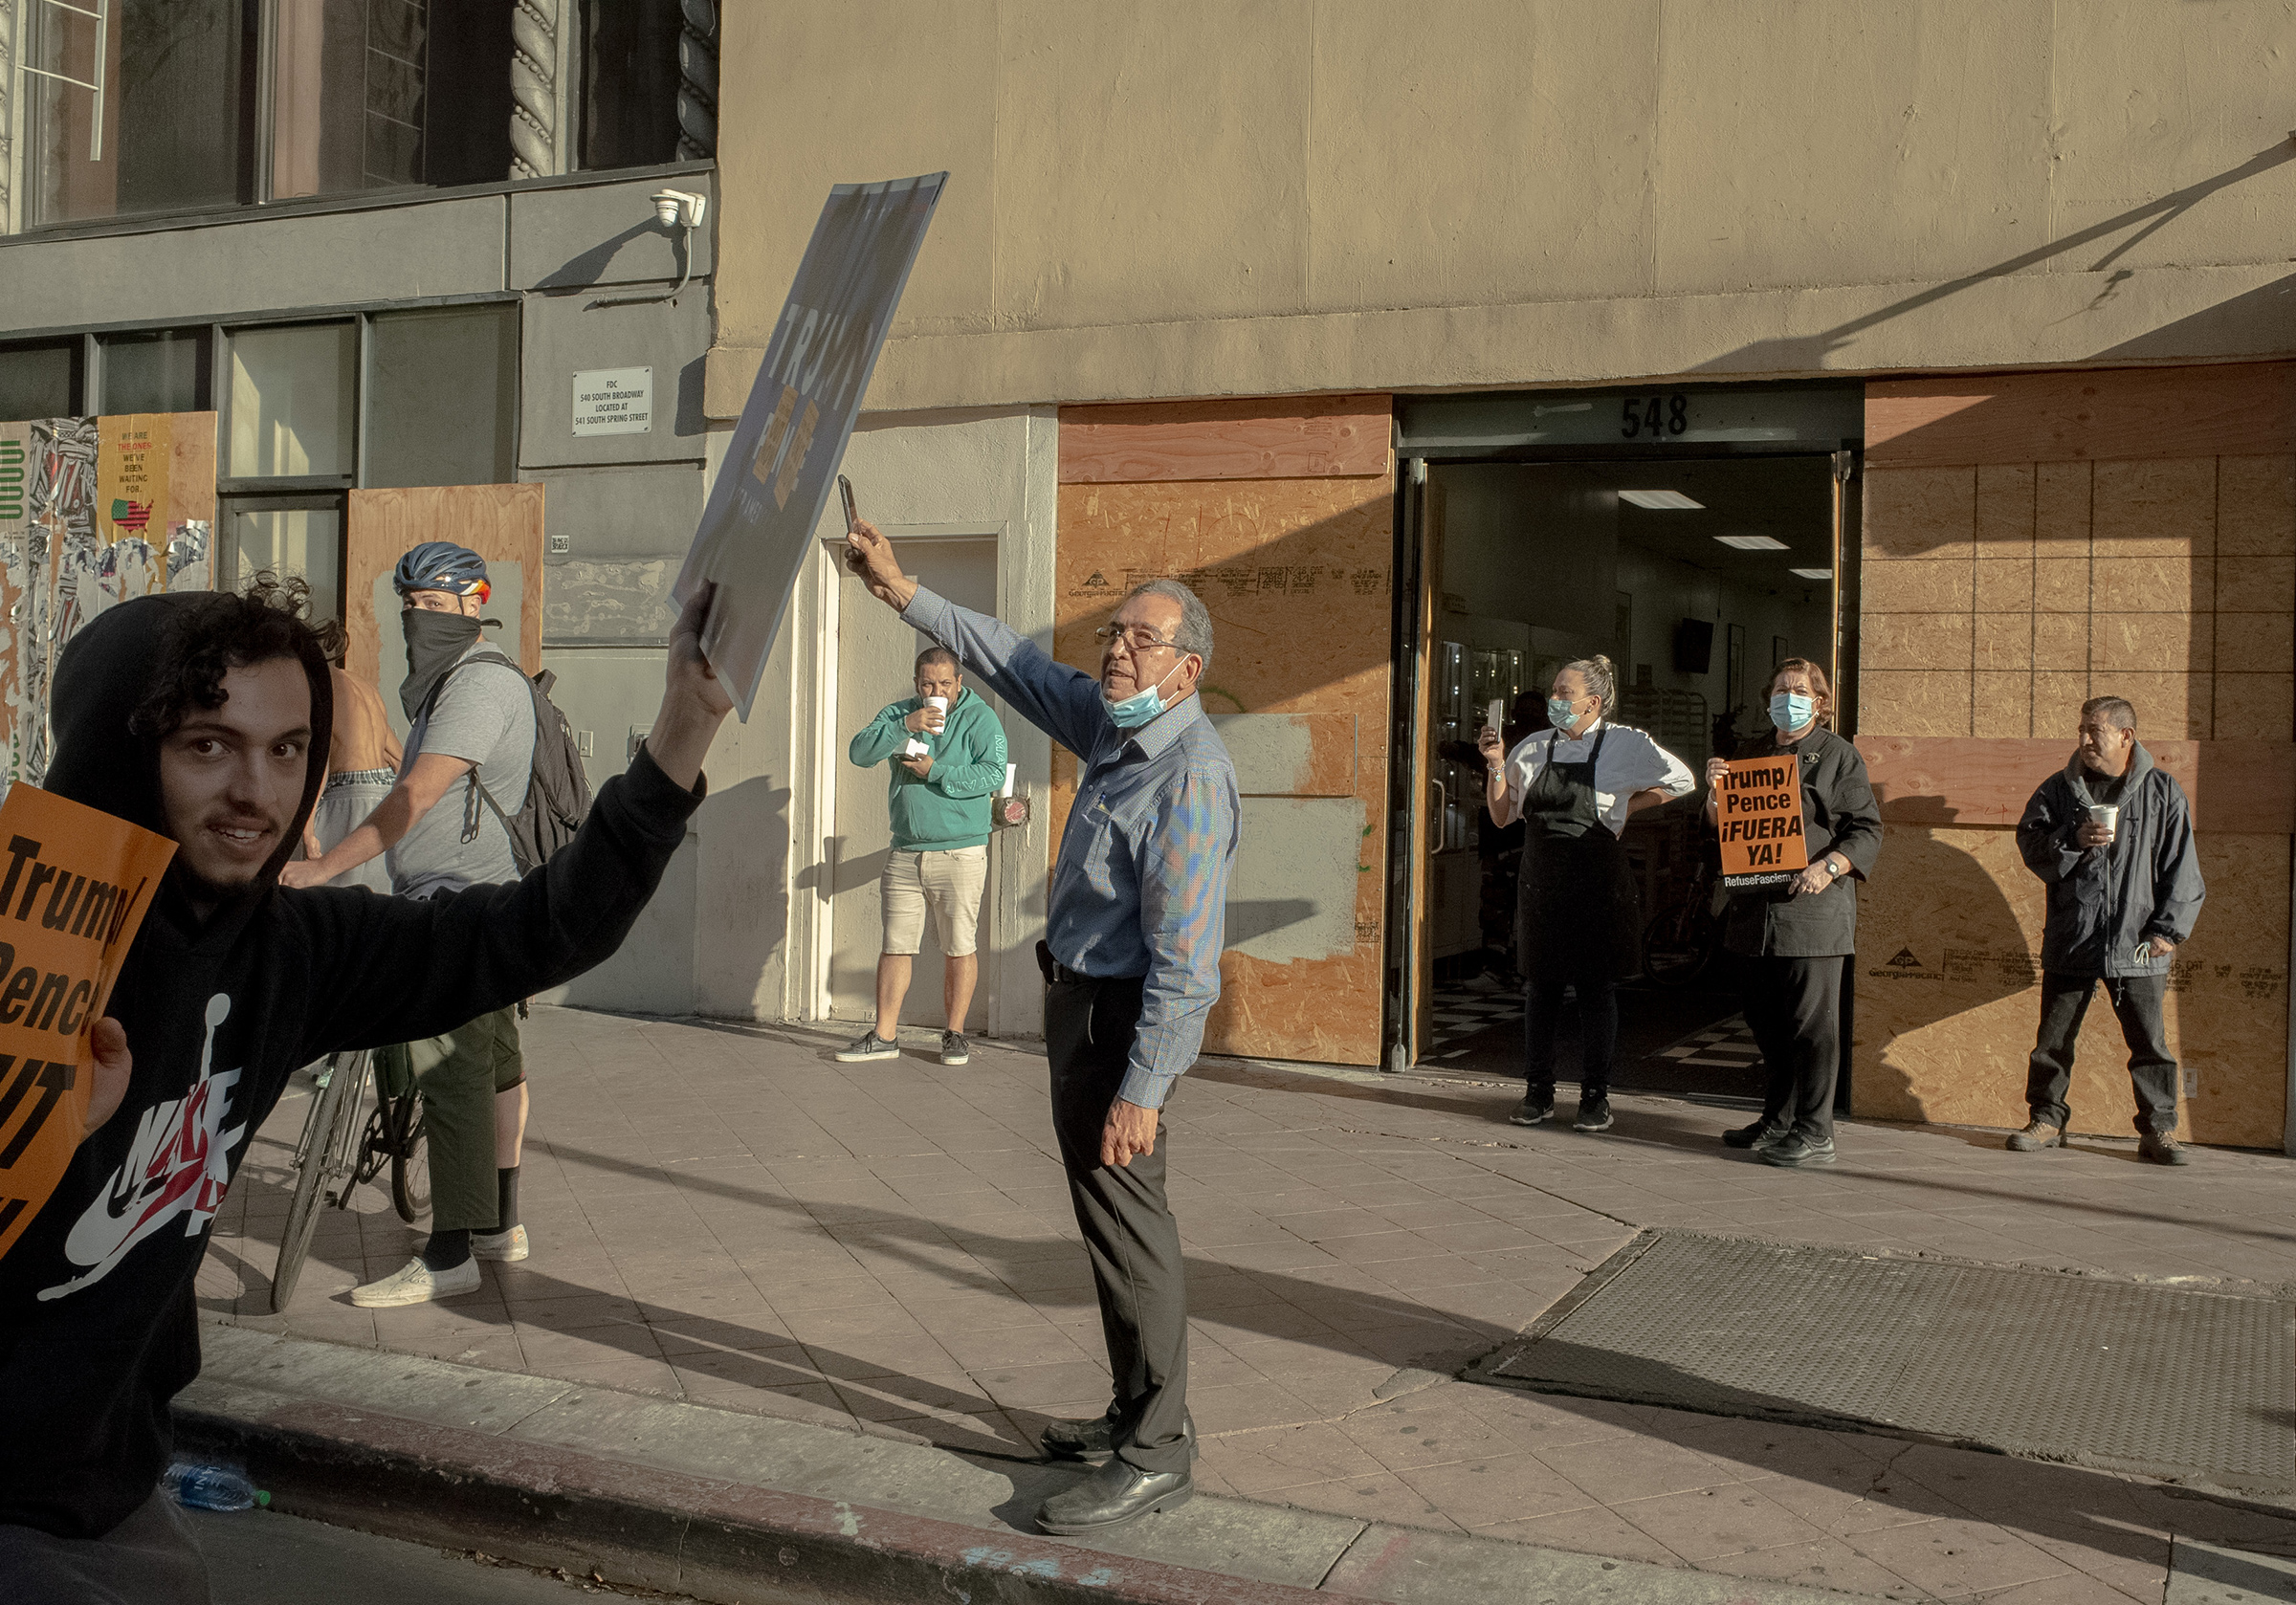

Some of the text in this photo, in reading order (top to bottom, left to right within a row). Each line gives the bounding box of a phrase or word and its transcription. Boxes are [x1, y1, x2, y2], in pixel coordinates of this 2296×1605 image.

[606, 380, 618, 388] FDC
[580, 389, 645, 403] 540 SOUTH BROADWAY
[595, 403, 629, 412] LOCATED AT
[575, 412, 649, 426] 541 SOUTH SPRING STREET
[1622, 394, 1687, 438] 548
[134, 431, 148, 440] ARE
[118, 442, 152, 451] THE ONES
[124, 464, 143, 473] BEEN
[119, 474, 148, 483] WAITING
[1727, 793, 1791, 814] Pence
[1722, 815, 1802, 843] ¡FUERA
[1746, 843, 1783, 867] YA!
[1724, 872, 1800, 888] RefuseFascism.o
